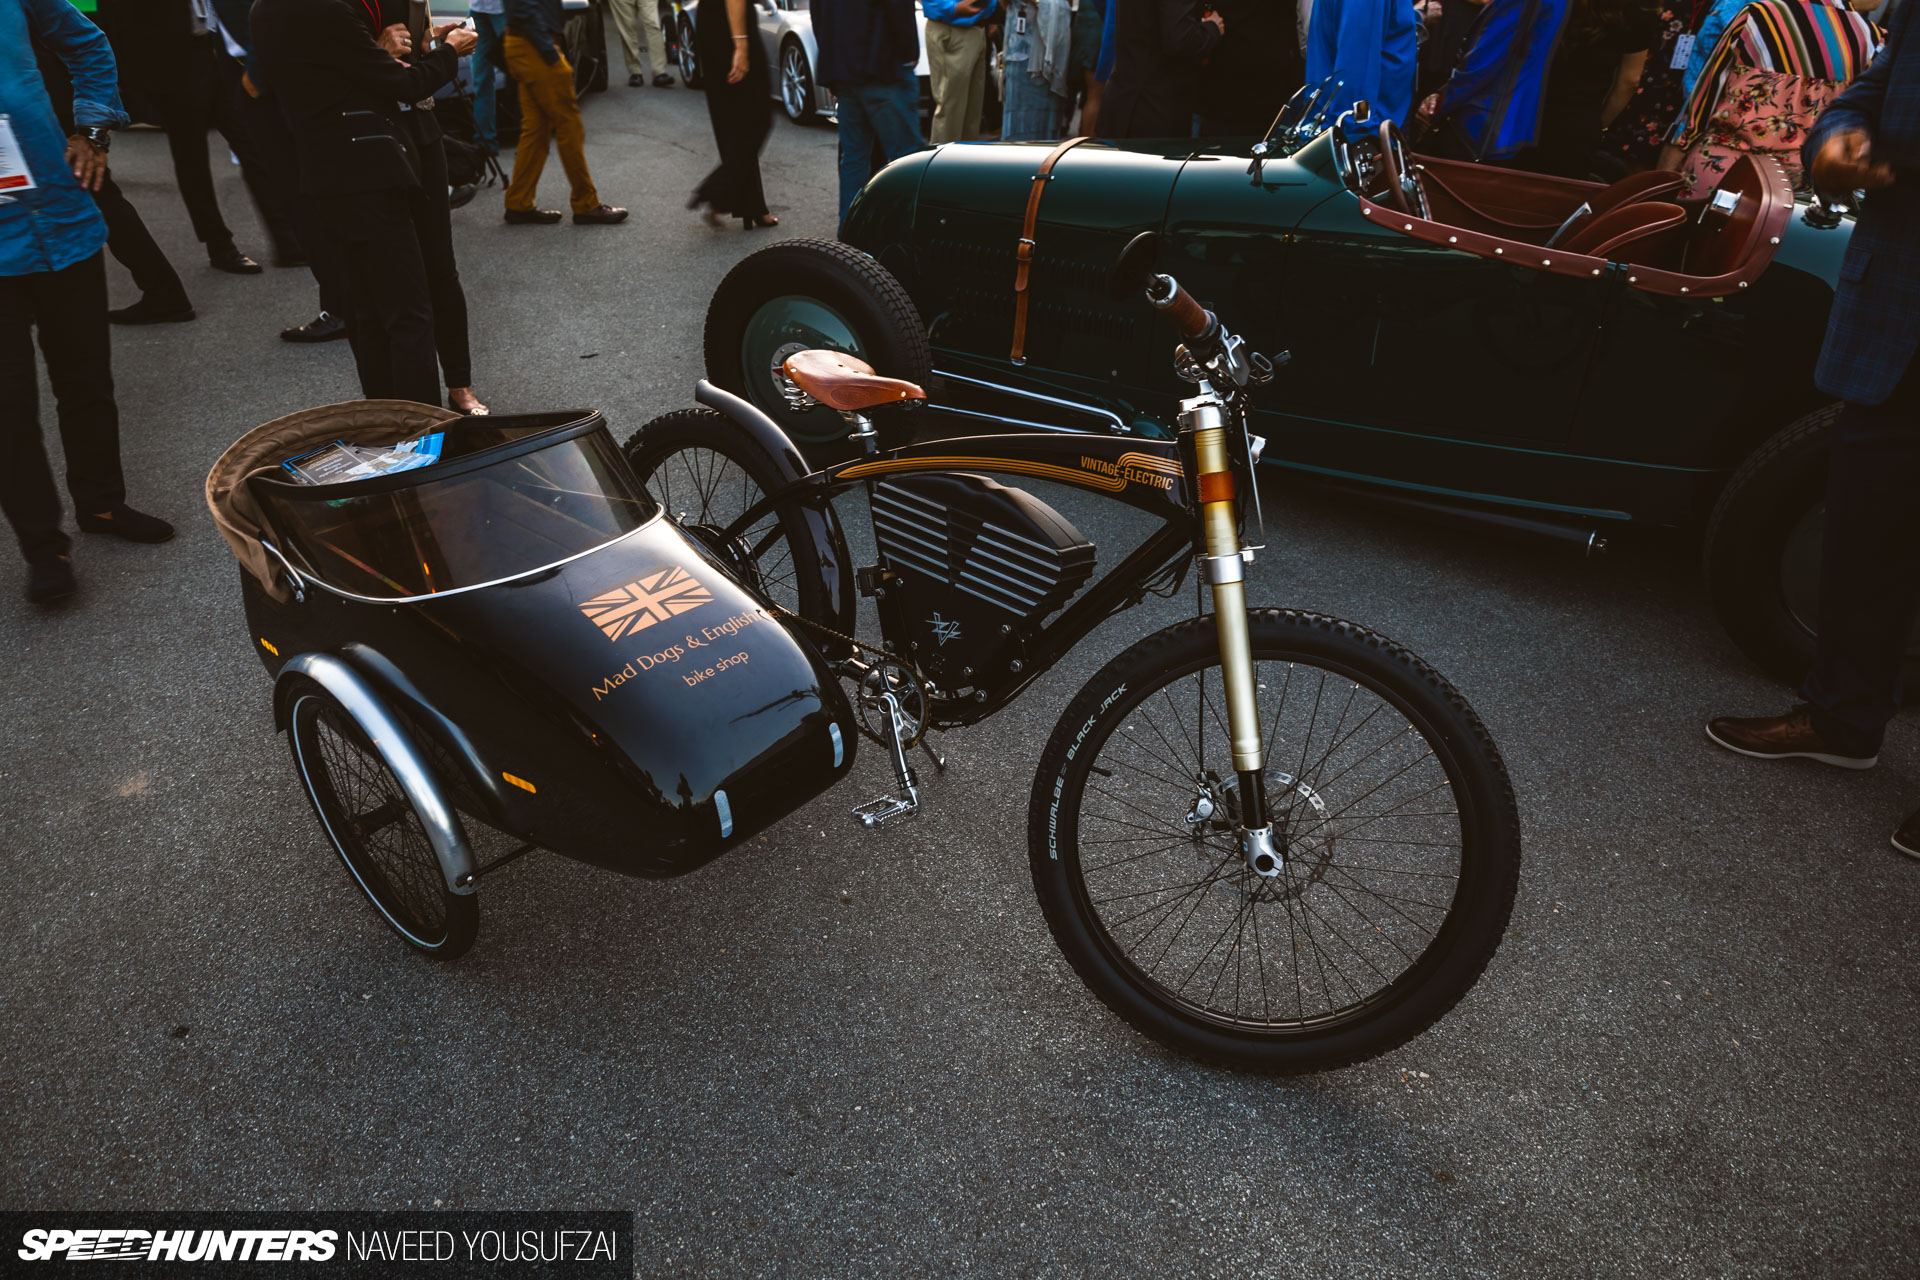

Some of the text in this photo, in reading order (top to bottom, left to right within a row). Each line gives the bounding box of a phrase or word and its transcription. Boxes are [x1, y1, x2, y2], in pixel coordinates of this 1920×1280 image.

[1081, 455, 1174, 491] VINTAGE-ELECTRIC
[591, 663, 638, 701] Mad
[636, 643, 685, 671] Dogs
[685, 635, 709, 649] &
[682, 651, 749, 687] bike shop
[1048, 682, 1128, 861] SCHWALBE BLACK JACK
